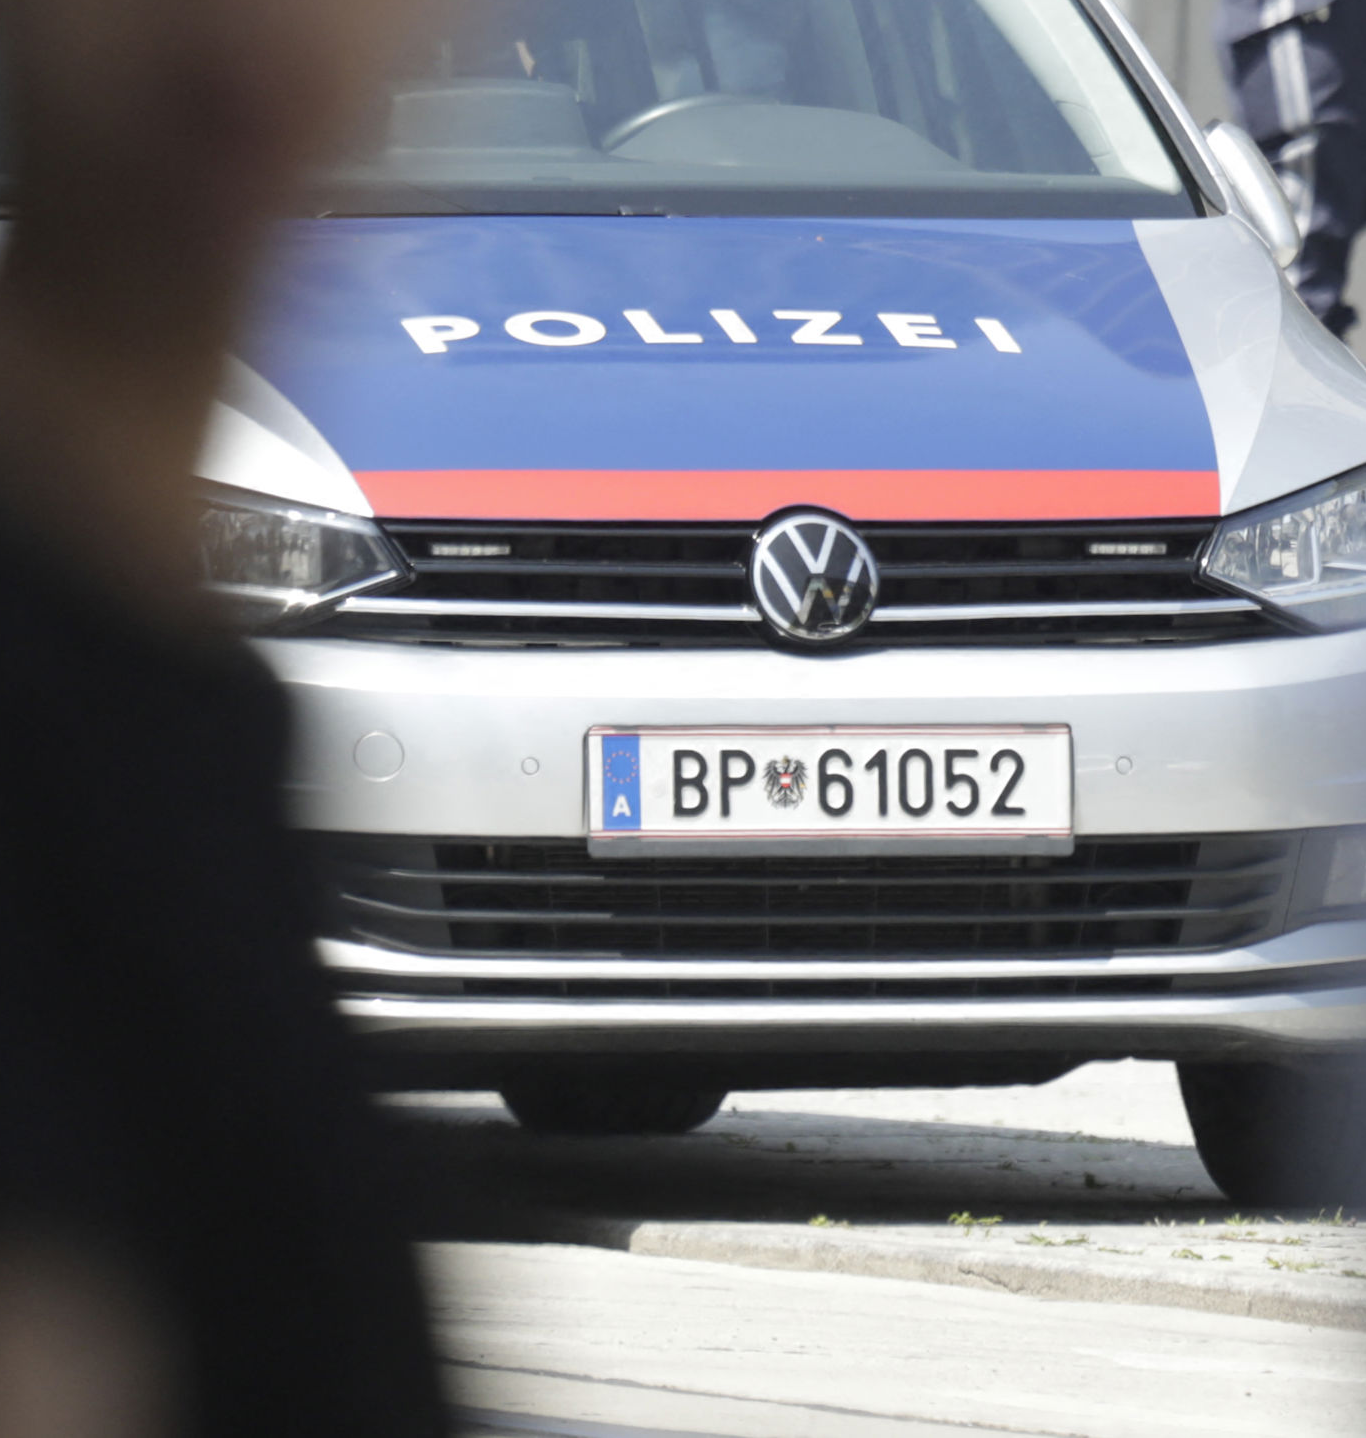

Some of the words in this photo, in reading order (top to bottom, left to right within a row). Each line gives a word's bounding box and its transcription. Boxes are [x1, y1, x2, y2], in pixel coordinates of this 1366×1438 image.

[399, 307, 1024, 355] POLIZEI
[611, 793, 633, 818] A
[672, 748, 757, 818] BP
[816, 748, 1027, 818] 61052
